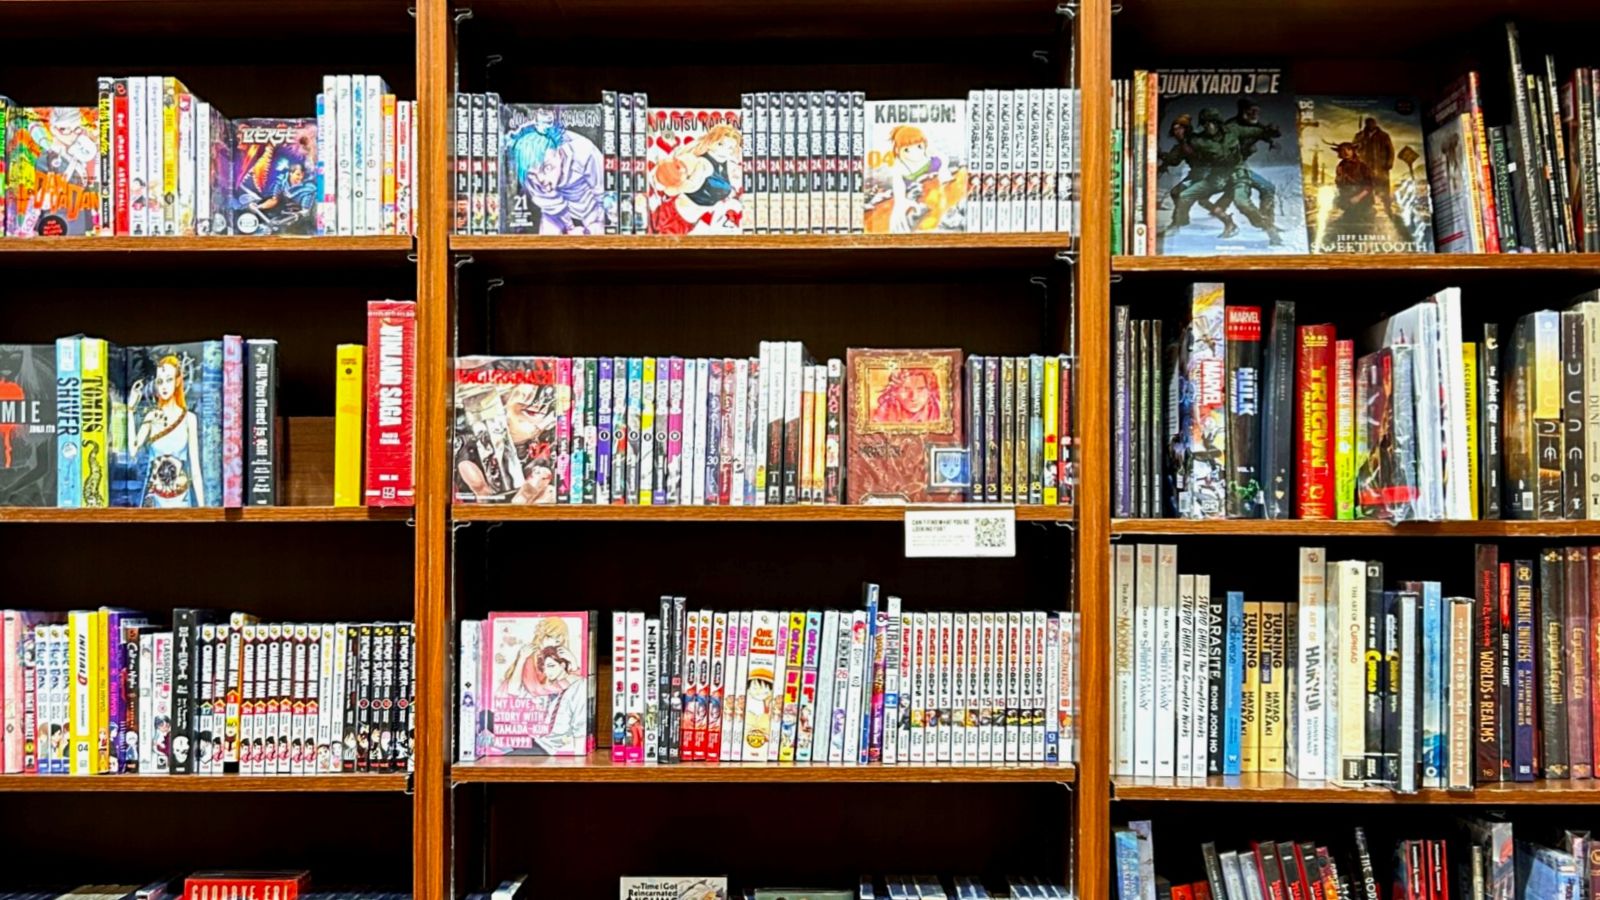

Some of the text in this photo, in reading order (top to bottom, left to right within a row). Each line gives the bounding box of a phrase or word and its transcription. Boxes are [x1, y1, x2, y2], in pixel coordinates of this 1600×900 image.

[1158, 74, 1280, 94] JUNKYARD JOE
[558, 109, 600, 127] KAISEN
[1299, 101, 1314, 109] DC
[652, 116, 698, 132] JUJUTSU
[867, 150, 895, 168] 04
[513, 196, 528, 210] 21
[1310, 241, 1429, 253] SWEET TOOTH
[1229, 311, 1260, 324] MARVEL
[379, 325, 403, 385] VINLAND
[1203, 360, 1222, 405] MARVEL
[1338, 358, 1350, 382] BRAVE
[256, 380, 268, 397] You
[1239, 367, 1254, 416] HULK
[1338, 383, 1350, 404] NEW
[1464, 363, 1472, 422] ACCIDENTALLY
[1, 401, 40, 423] MIE
[57, 376, 80, 437] SHIVER
[81, 376, 103, 433] TOMBS
[379, 386, 403, 427] SAGA
[1311, 366, 1328, 468] TRIGUN
[706, 456, 718, 465] 30
[974, 485, 982, 493] 2
[1518, 567, 1531, 580] DC
[756, 628, 773, 638] ONE
[1263, 613, 1272, 651] POINT
[1518, 585, 1531, 663] CINEMATIC UNIVERSE
[615, 636, 625, 672] NANA
[700, 626, 709, 656] ONE PIECE
[752, 636, 775, 647] PIECE
[790, 628, 801, 664] ONE PIECE
[806, 628, 817, 665] ONE PIECE
[1116, 616, 1130, 677] MONONOKE
[1209, 603, 1222, 680] PARASITE
[1247, 613, 1257, 669] TURNING
[1273, 613, 1282, 669] TURNING
[1305, 592, 1321, 712] THE ART OF HAIKYU!!
[1350, 623, 1360, 664] CUPHEAD
[1502, 633, 1510, 650] GLORY
[78, 634, 88, 686] INITIAL D
[163, 638, 171, 684] CLASSROOM
[630, 639, 640, 673] NANA
[1180, 595, 1191, 738] STUDIO GHIBLI The Complete Works
[1196, 595, 1207, 738] STUDIO GHIBLI The Complete Works
[836, 669, 848, 679] 26
[1365, 650, 1381, 693] CUPHEAD
[1480, 651, 1494, 693] WORLDS
[495, 699, 533, 709] MY LOVE
[928, 699, 935, 707] 3
[941, 698, 947, 706] 5
[955, 699, 965, 707] 11
[968, 699, 978, 707] 14
[995, 699, 1005, 707] 16
[1139, 685, 1148, 711] AWAY
[1160, 685, 1169, 711] AWAY
[495, 711, 544, 721] STORY WITH
[1210, 685, 1218, 753] BONG JOON HO
[1264, 691, 1272, 736] MIYAZAKI
[1456, 658, 1465, 776] GHOST OF TSUSHIMA
[1480, 701, 1494, 743] REALMS
[495, 724, 550, 734] YAMADA-KUN
[1048, 733, 1056, 742] 9
[77, 743, 88, 752] 04
[1360, 853, 1371, 874] THE
[628, 889, 678, 897] Reincarnated
